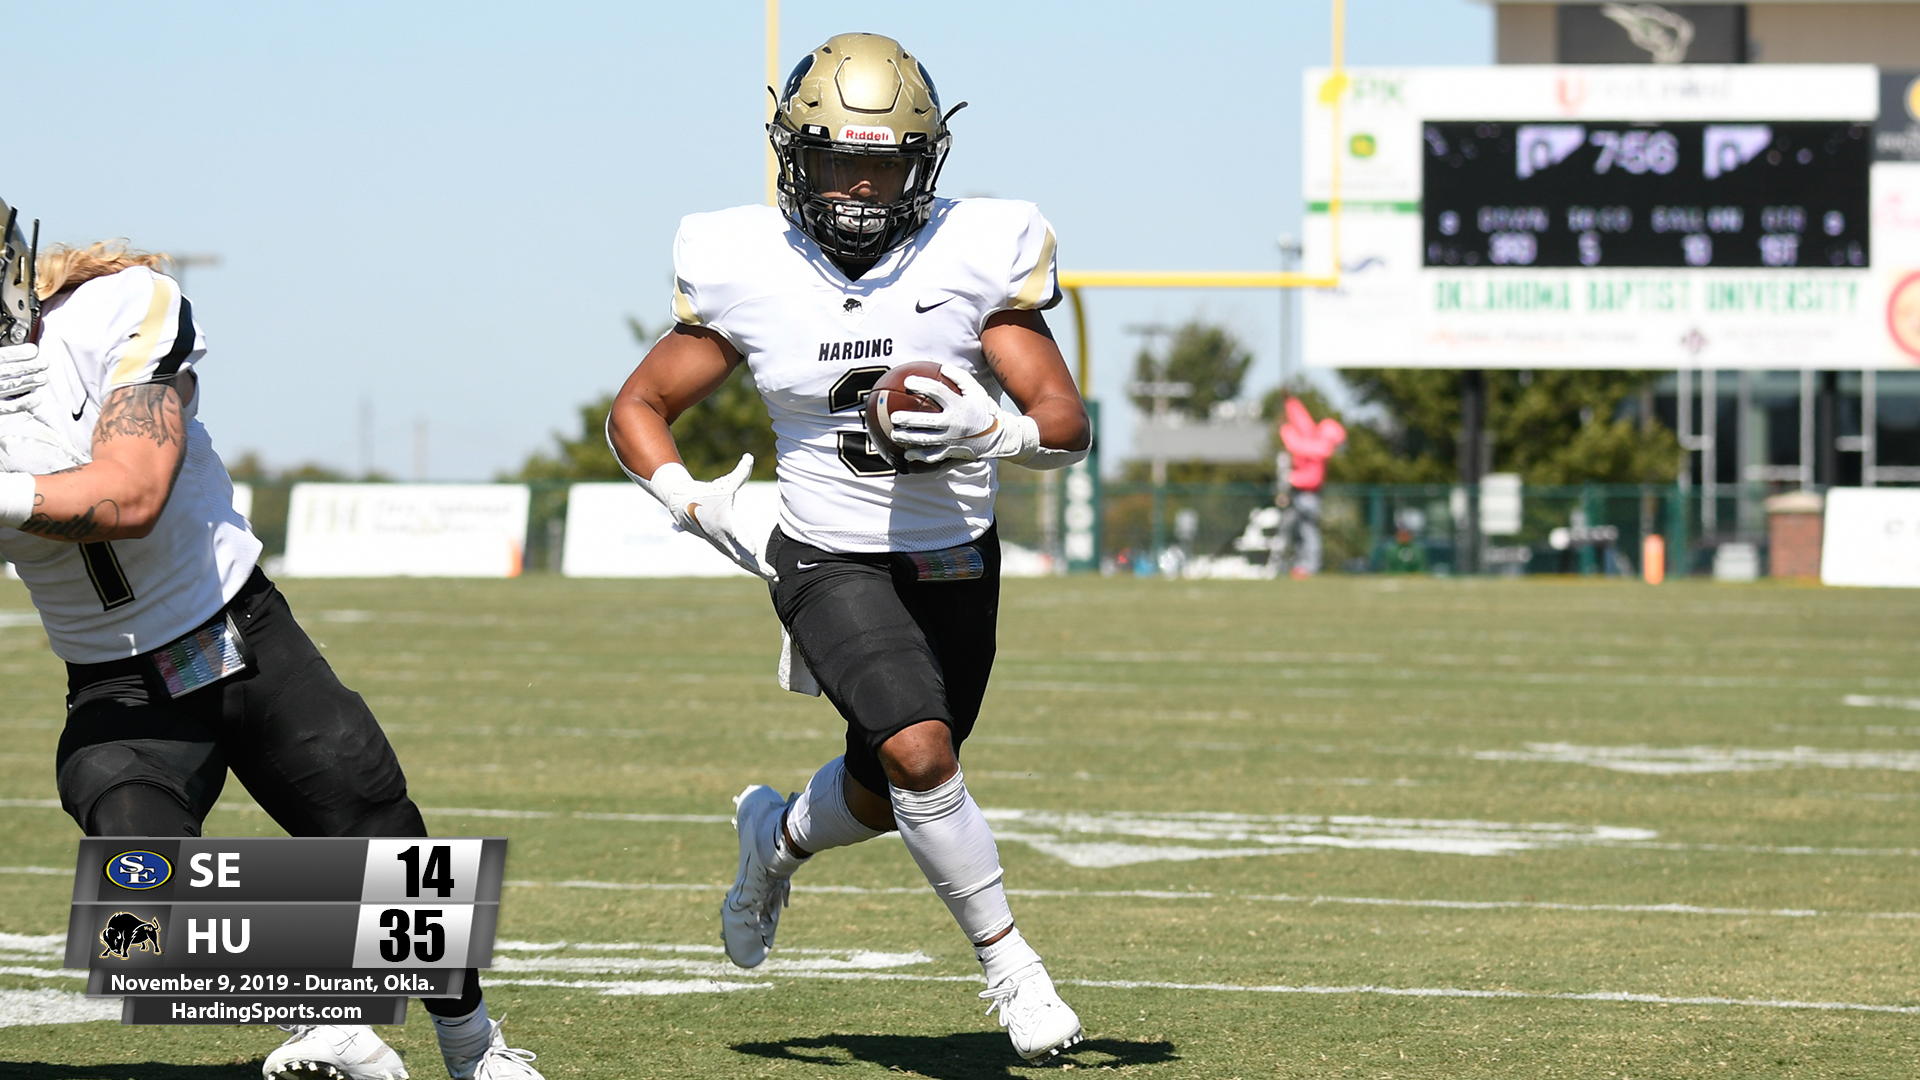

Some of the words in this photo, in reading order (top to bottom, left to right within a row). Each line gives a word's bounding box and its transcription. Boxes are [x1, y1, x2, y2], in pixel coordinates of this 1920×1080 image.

[845, 129, 889, 141] Riddell
[1434, 279, 1571, 312] OKLAHOMA
[1586, 280, 1690, 311] BAPTIST
[1704, 279, 1859, 312] UNIVERSITY
[818, 338, 893, 361] HARDING
[828, 365, 899, 477] 3
